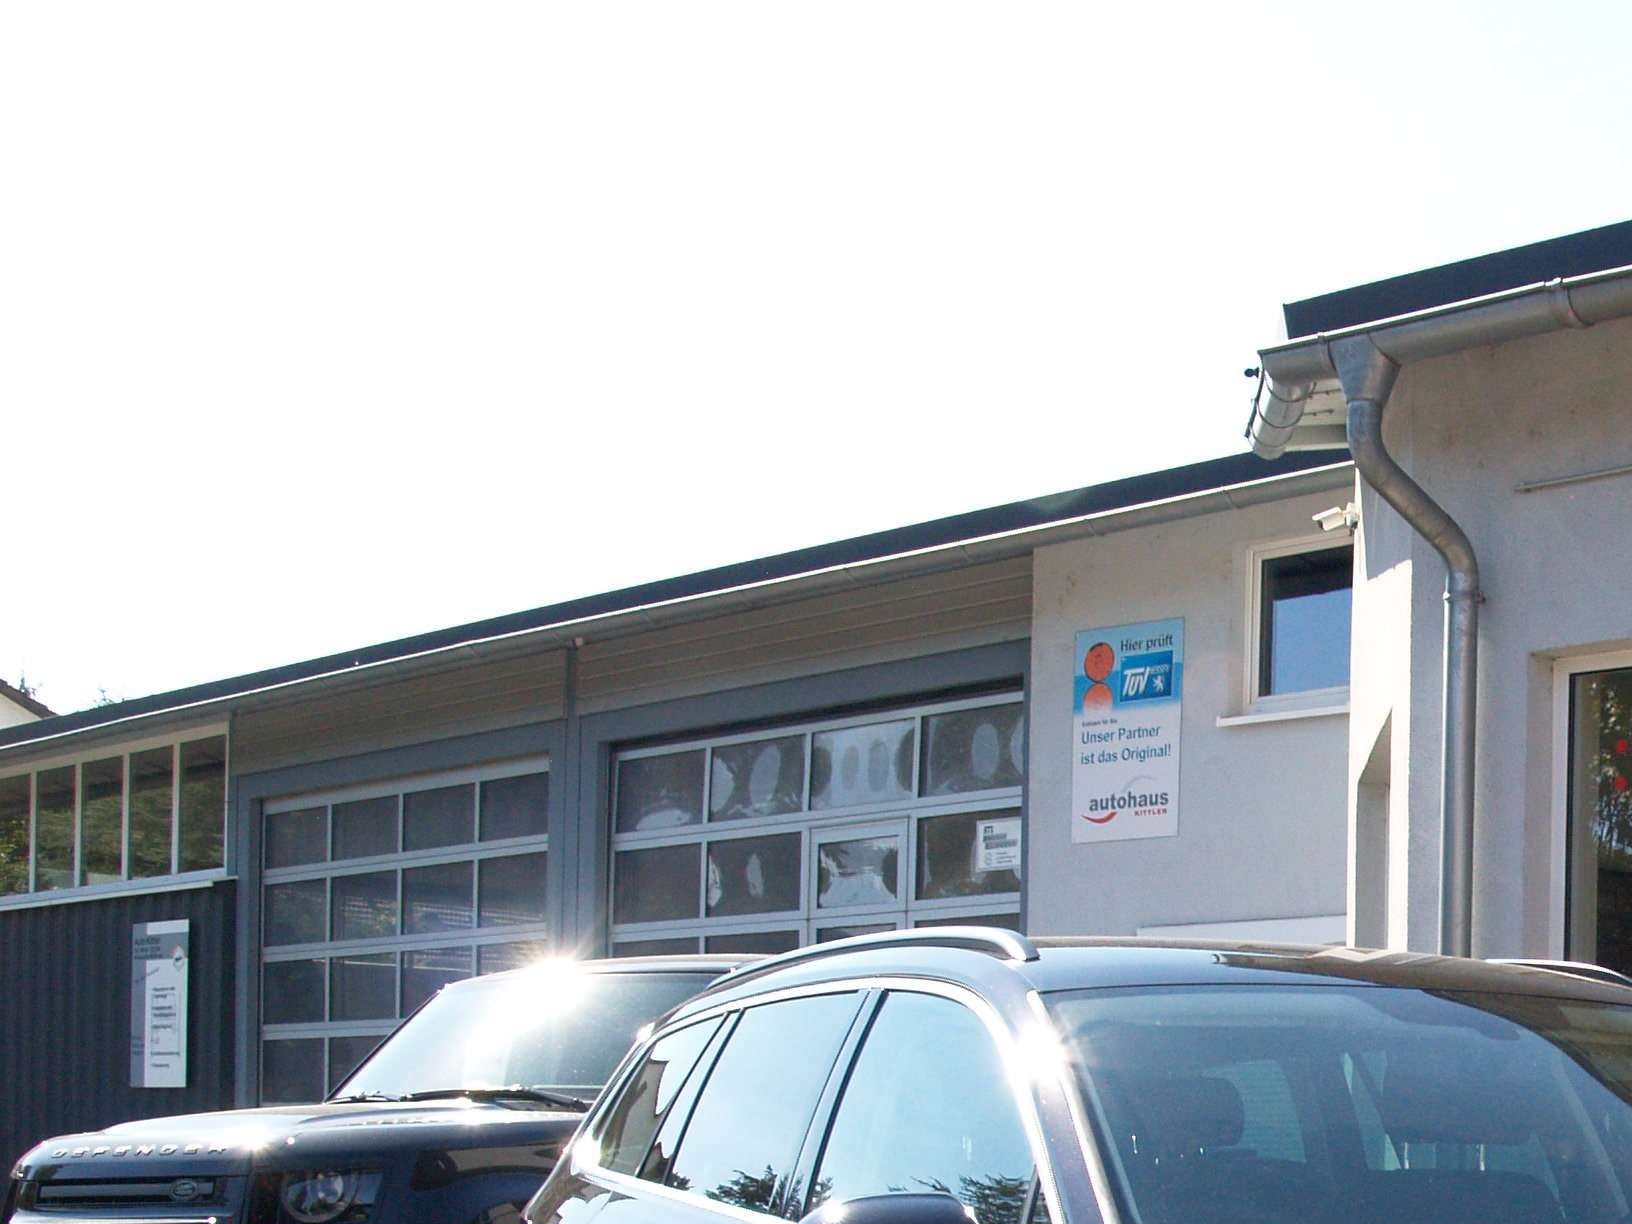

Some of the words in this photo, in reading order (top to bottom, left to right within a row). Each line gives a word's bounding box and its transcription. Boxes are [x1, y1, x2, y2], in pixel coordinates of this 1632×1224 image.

[1120, 639, 1143, 652] Hier
[1146, 634, 1174, 651] prüft
[1081, 729, 1115, 745] Unser
[1118, 726, 1161, 741] Partner
[1080, 752, 1095, 765] ist
[1098, 749, 1118, 764] das
[1121, 744, 1171, 763] Original!
[1088, 791, 1169, 812] autohaus
[1134, 808, 1168, 816] KITTLER
[51, 1143, 229, 1159] DEFENDER
